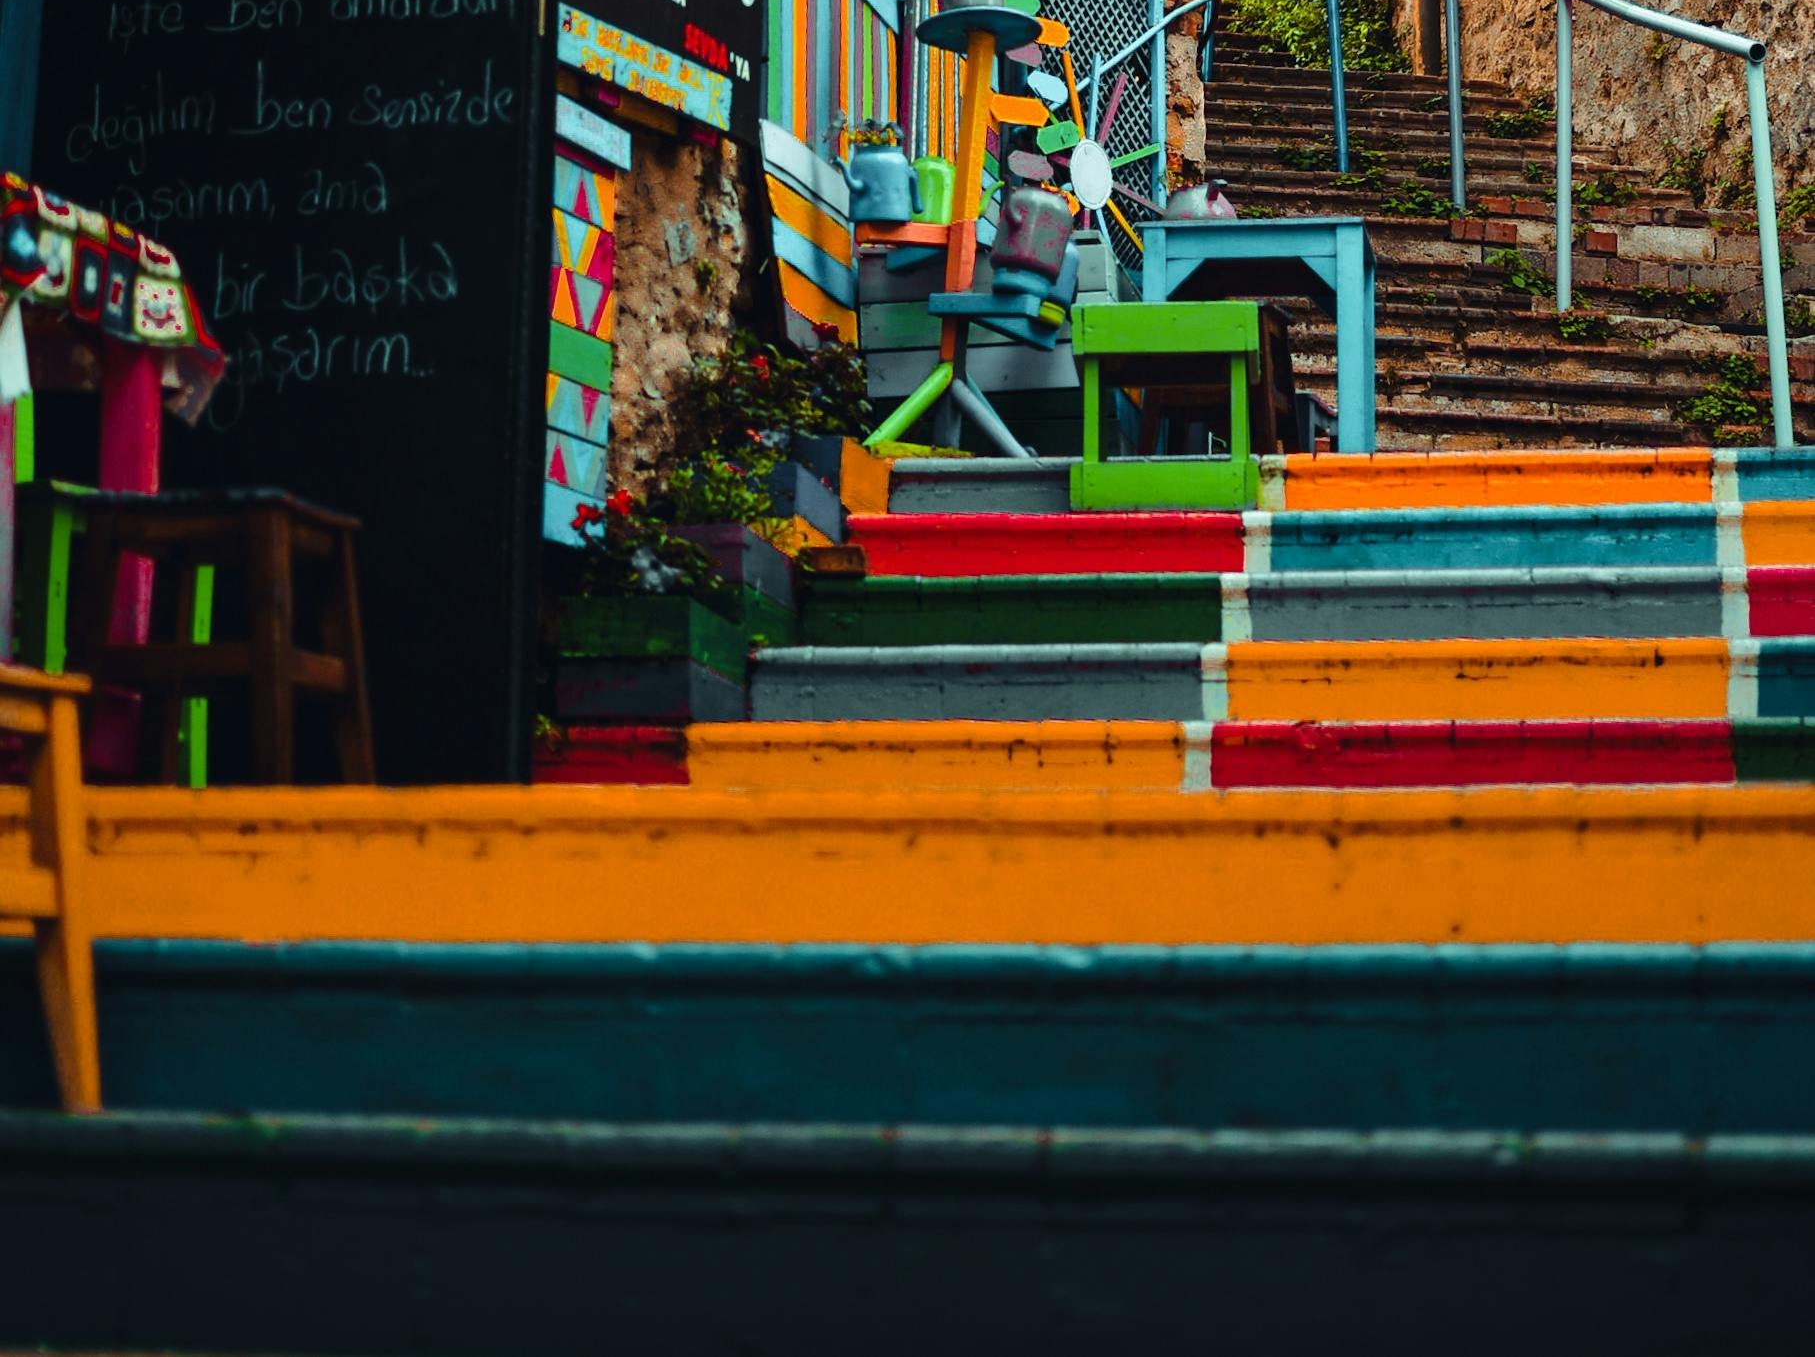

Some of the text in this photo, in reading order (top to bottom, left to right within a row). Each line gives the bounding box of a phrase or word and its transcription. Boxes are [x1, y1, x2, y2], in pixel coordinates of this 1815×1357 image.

[226, 58, 334, 136] ben
[213, 237, 459, 321] bir başka
